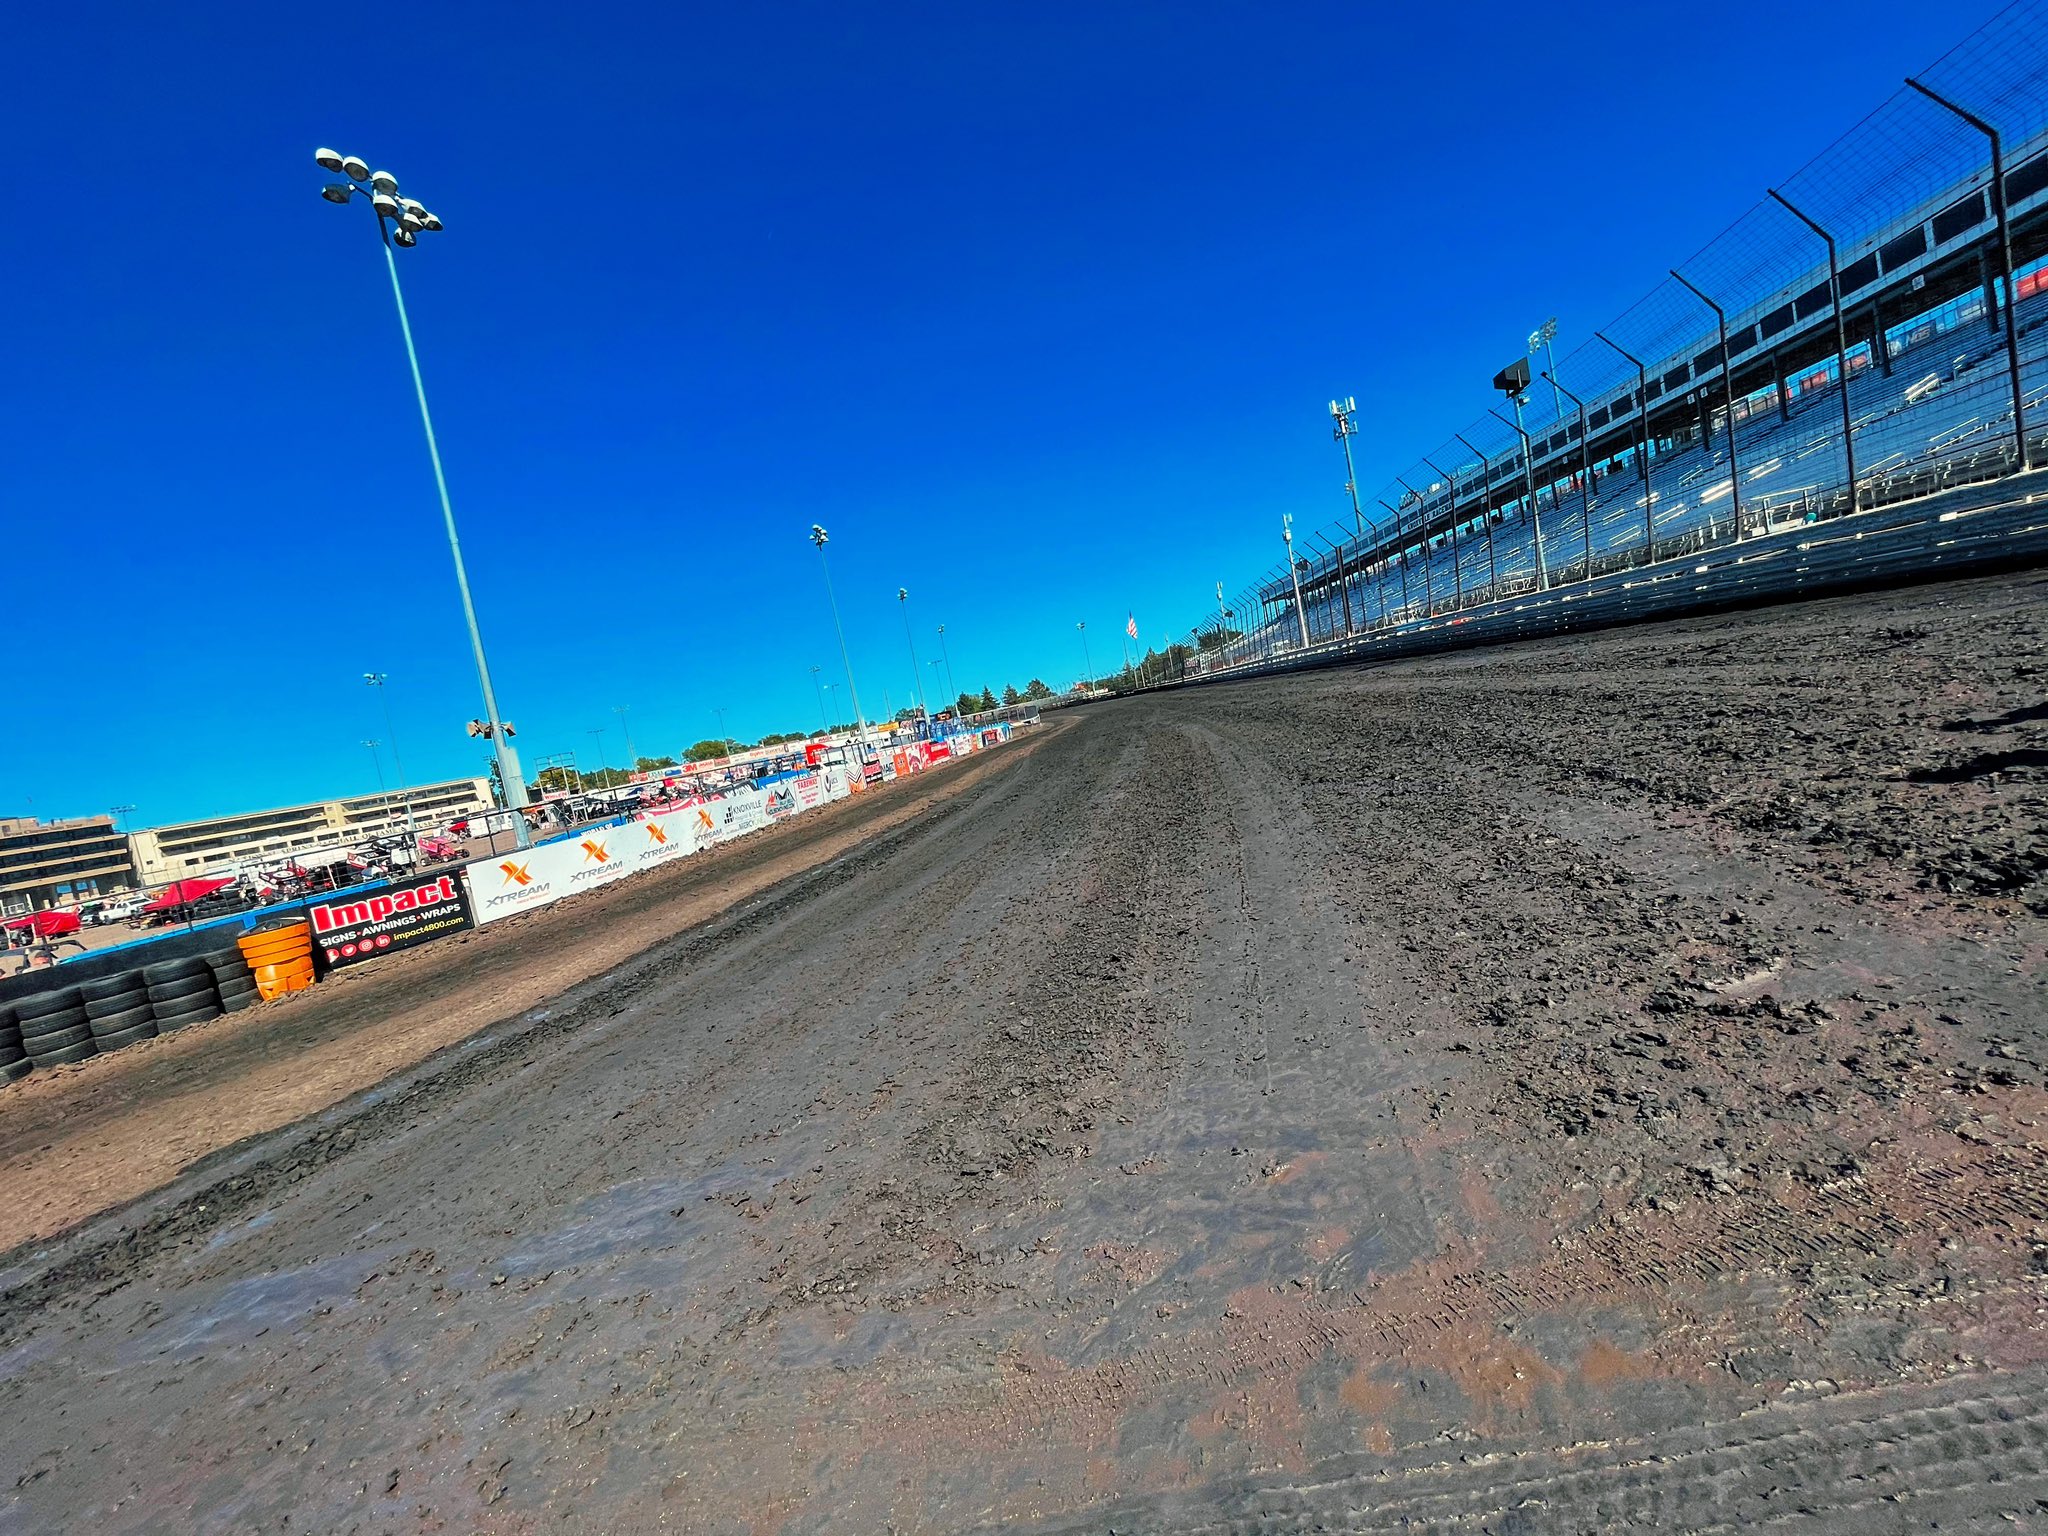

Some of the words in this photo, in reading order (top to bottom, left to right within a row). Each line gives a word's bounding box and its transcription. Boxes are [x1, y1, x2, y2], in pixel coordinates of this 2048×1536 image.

[682, 763, 698, 773] 3M
[733, 799, 762, 815] KNOXVILLE
[336, 834, 359, 844] HALL
[638, 842, 679, 862] XTREAM
[569, 859, 624, 884] XTREAM
[310, 874, 459, 935] Impact
[486, 881, 550, 909] XTREAM
[319, 930, 358, 948] SIGNS
[361, 914, 418, 937] AWNINGS
[419, 903, 461, 920] WRAPS
[393, 915, 465, 942] impact4800.com
